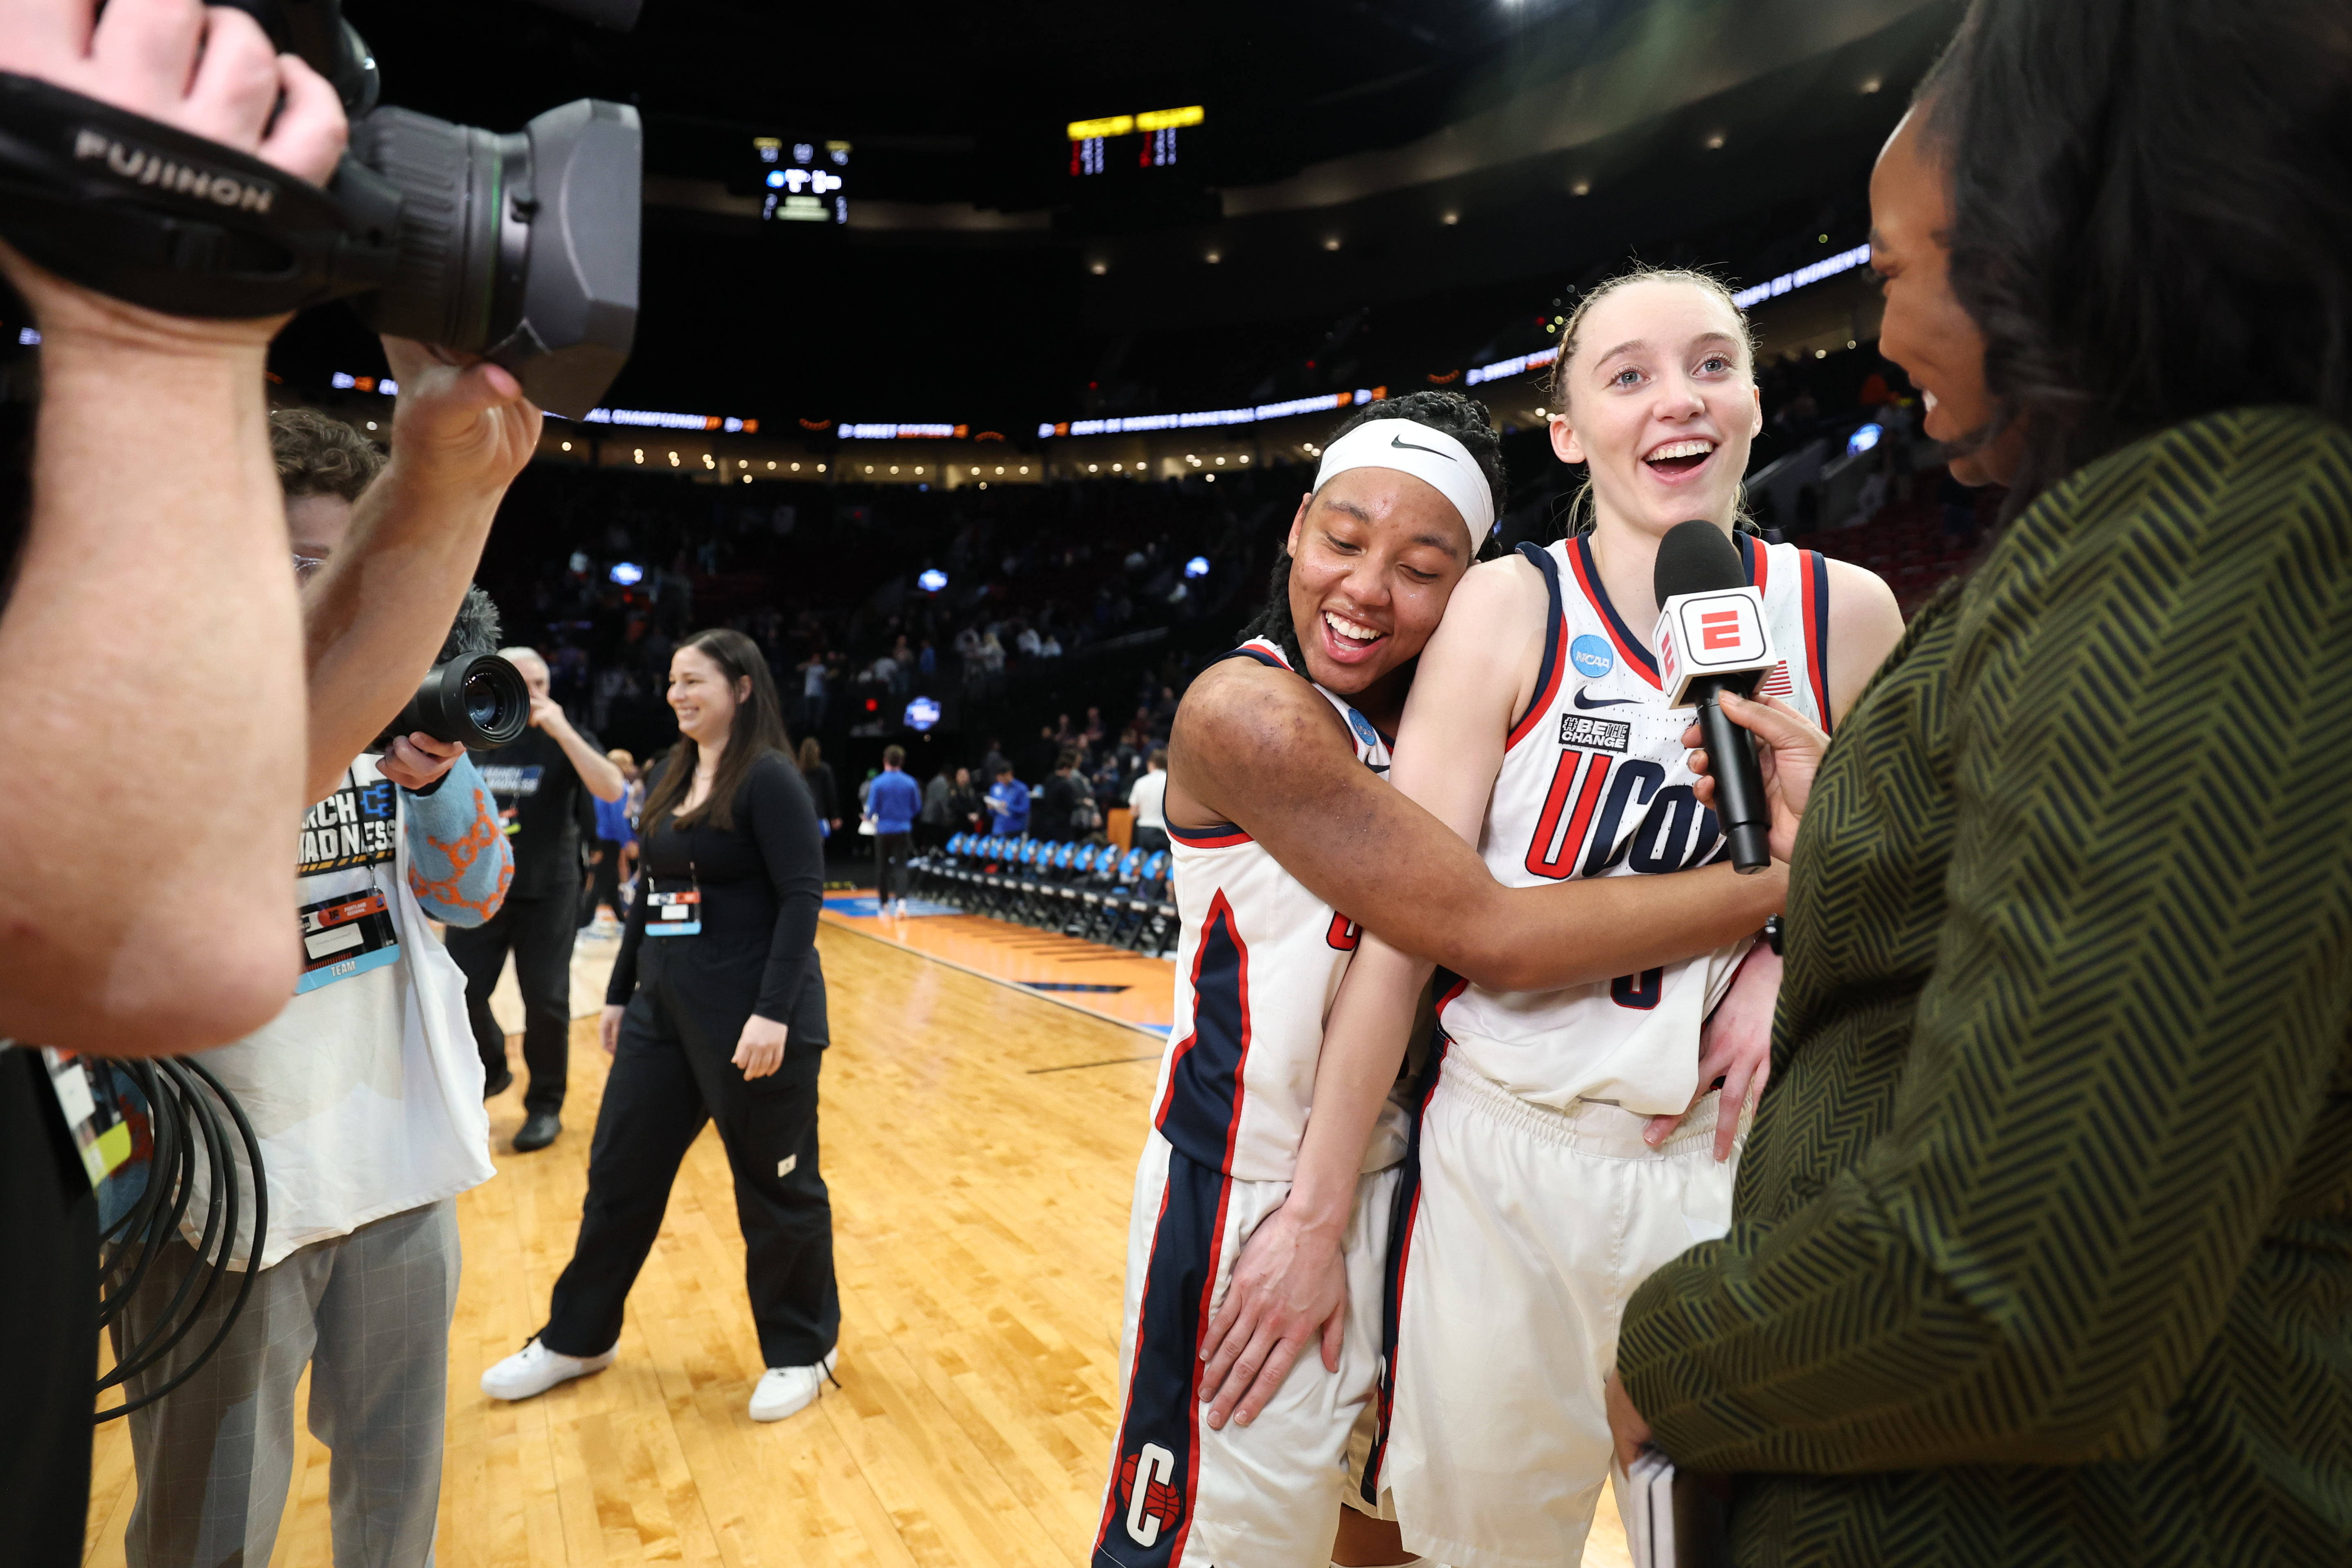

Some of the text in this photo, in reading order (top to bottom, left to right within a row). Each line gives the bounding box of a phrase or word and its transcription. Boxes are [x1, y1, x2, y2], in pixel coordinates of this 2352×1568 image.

[74, 130, 273, 213] FUJINON
[1701, 610, 1741, 650] E
[1575, 650, 1611, 669] NCAA
[1561, 731, 1626, 749] CHANGE
[1525, 748, 1731, 880] UCO
[344, 901, 367, 913] PORTLAND
[330, 960, 356, 978] TEAM
[1126, 1442, 1175, 1547] C
